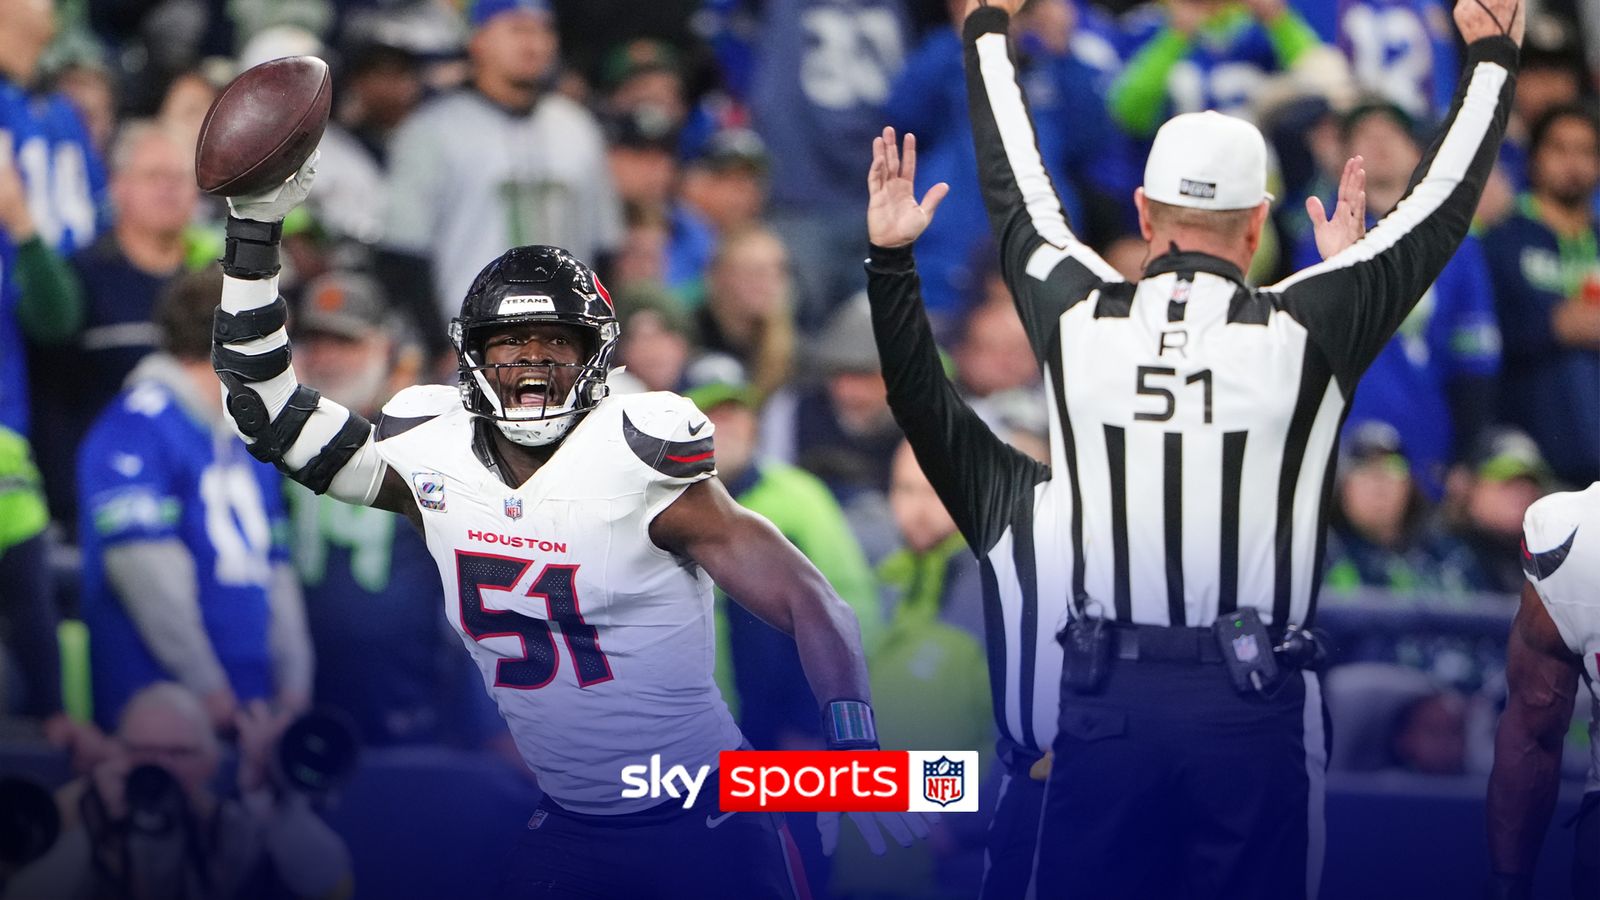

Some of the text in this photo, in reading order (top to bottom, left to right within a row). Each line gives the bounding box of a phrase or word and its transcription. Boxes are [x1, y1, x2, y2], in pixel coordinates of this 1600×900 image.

[1158, 330, 1188, 358] R
[1133, 365, 1213, 424] 51
[468, 529, 567, 553] HOUSTON
[454, 549, 615, 691] 51
